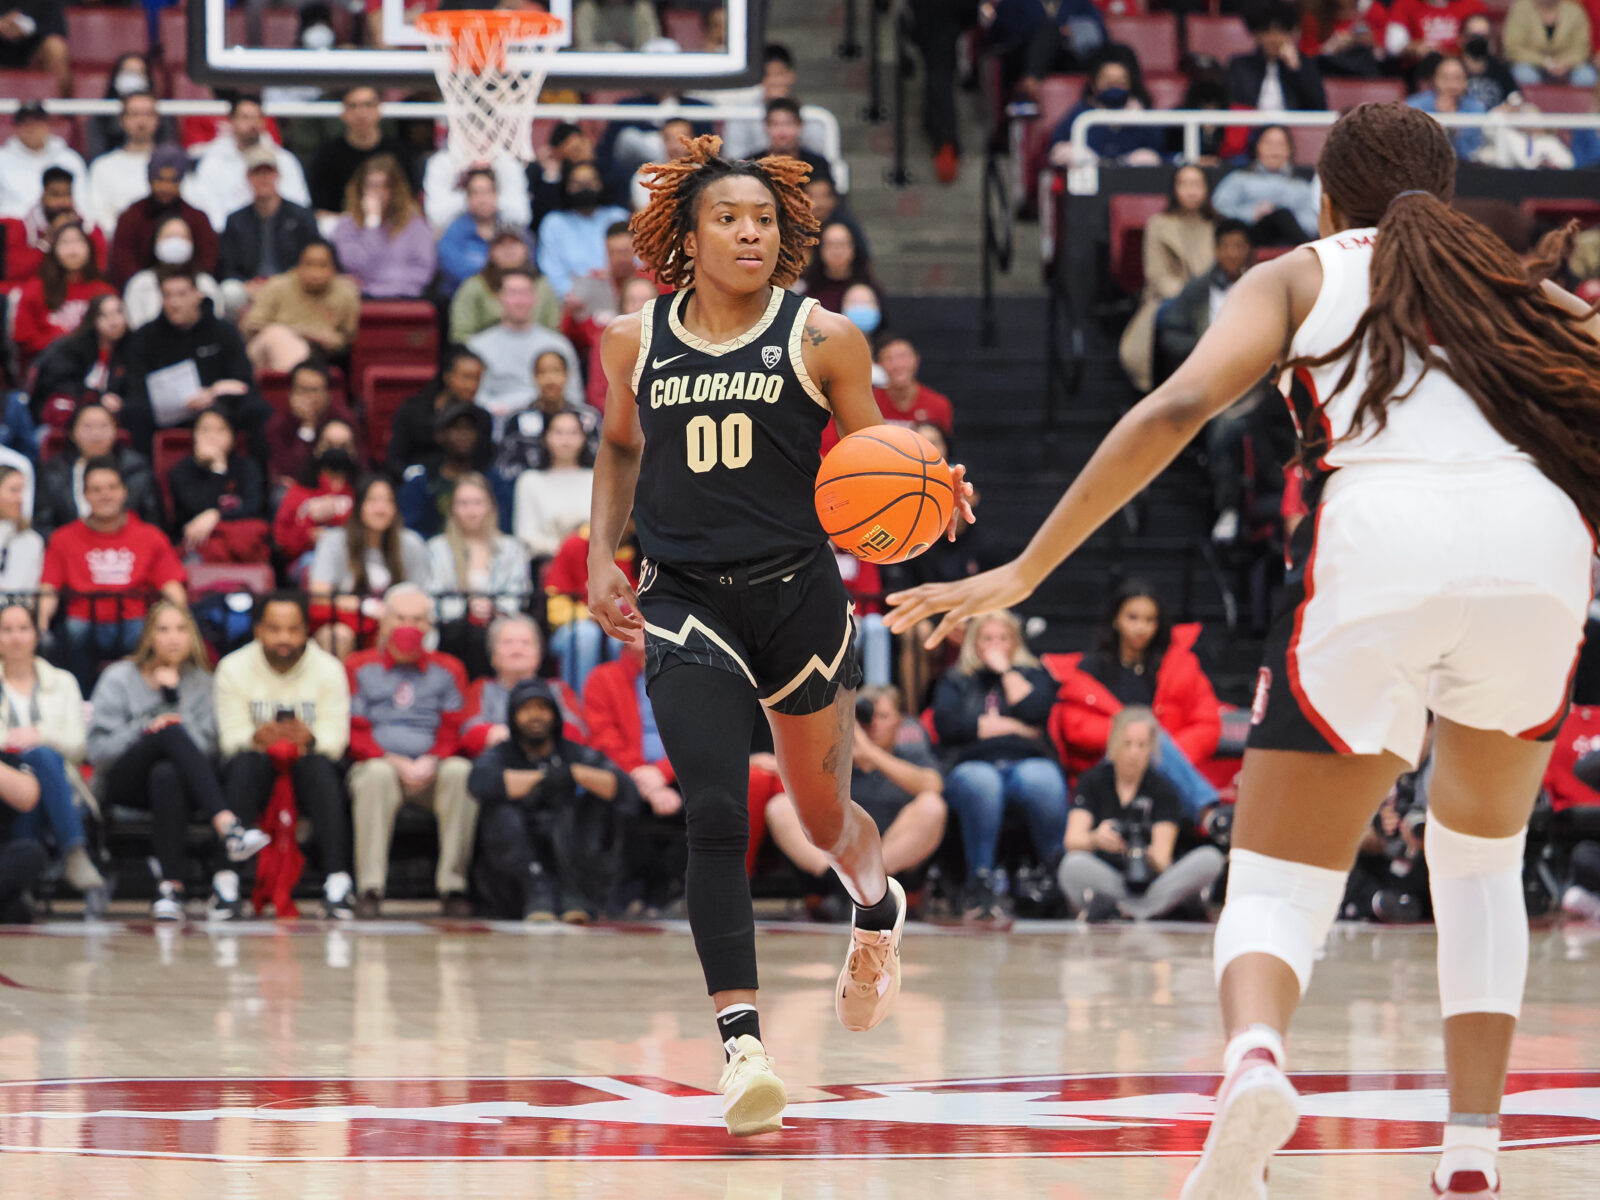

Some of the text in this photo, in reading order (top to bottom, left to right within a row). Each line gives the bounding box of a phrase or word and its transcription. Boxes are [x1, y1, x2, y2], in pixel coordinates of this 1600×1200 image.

[1336, 235, 1377, 250] EM
[766, 355, 776, 364] 12
[650, 371, 785, 410] COLORADO
[686, 412, 753, 474] 00
